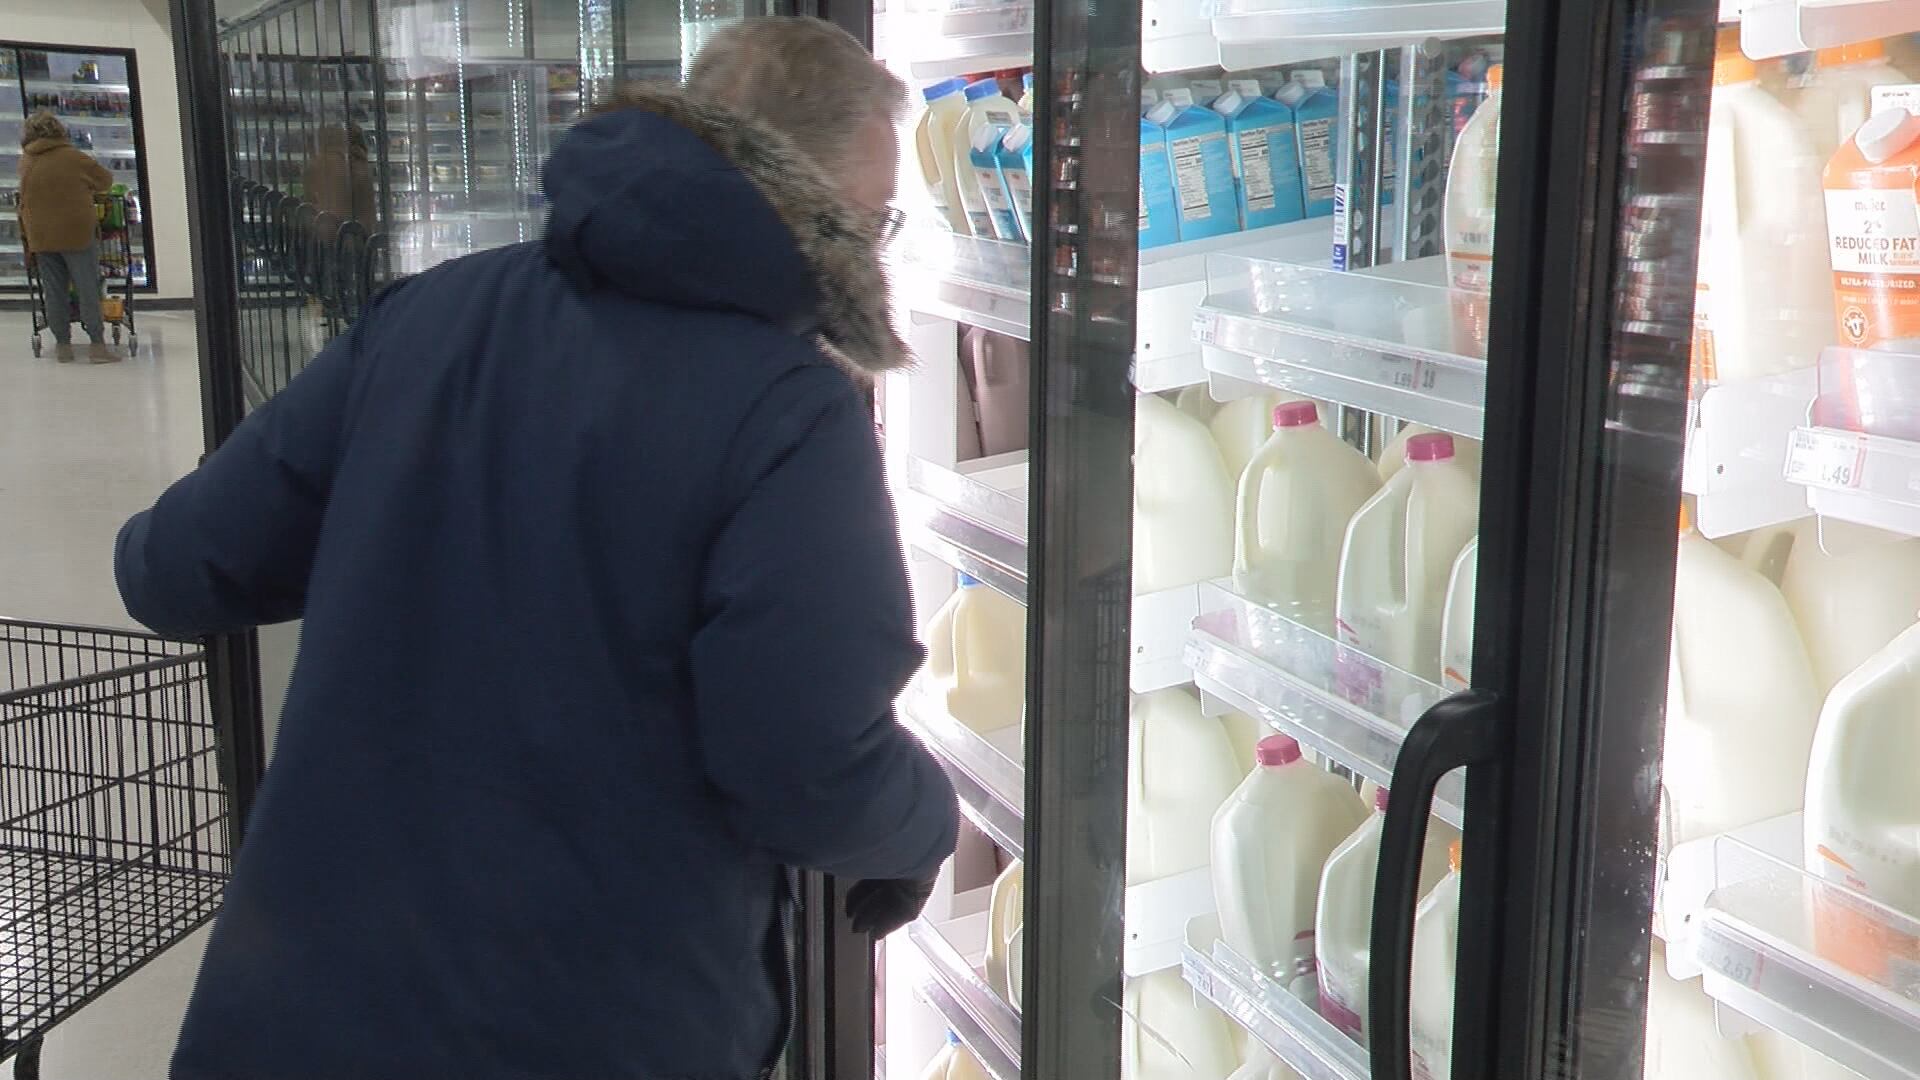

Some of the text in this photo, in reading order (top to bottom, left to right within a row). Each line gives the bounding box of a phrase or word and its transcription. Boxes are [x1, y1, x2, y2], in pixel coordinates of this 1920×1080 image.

[1835, 236, 1917, 251] REDUCED FAT
[1858, 252, 1888, 266] MILK
